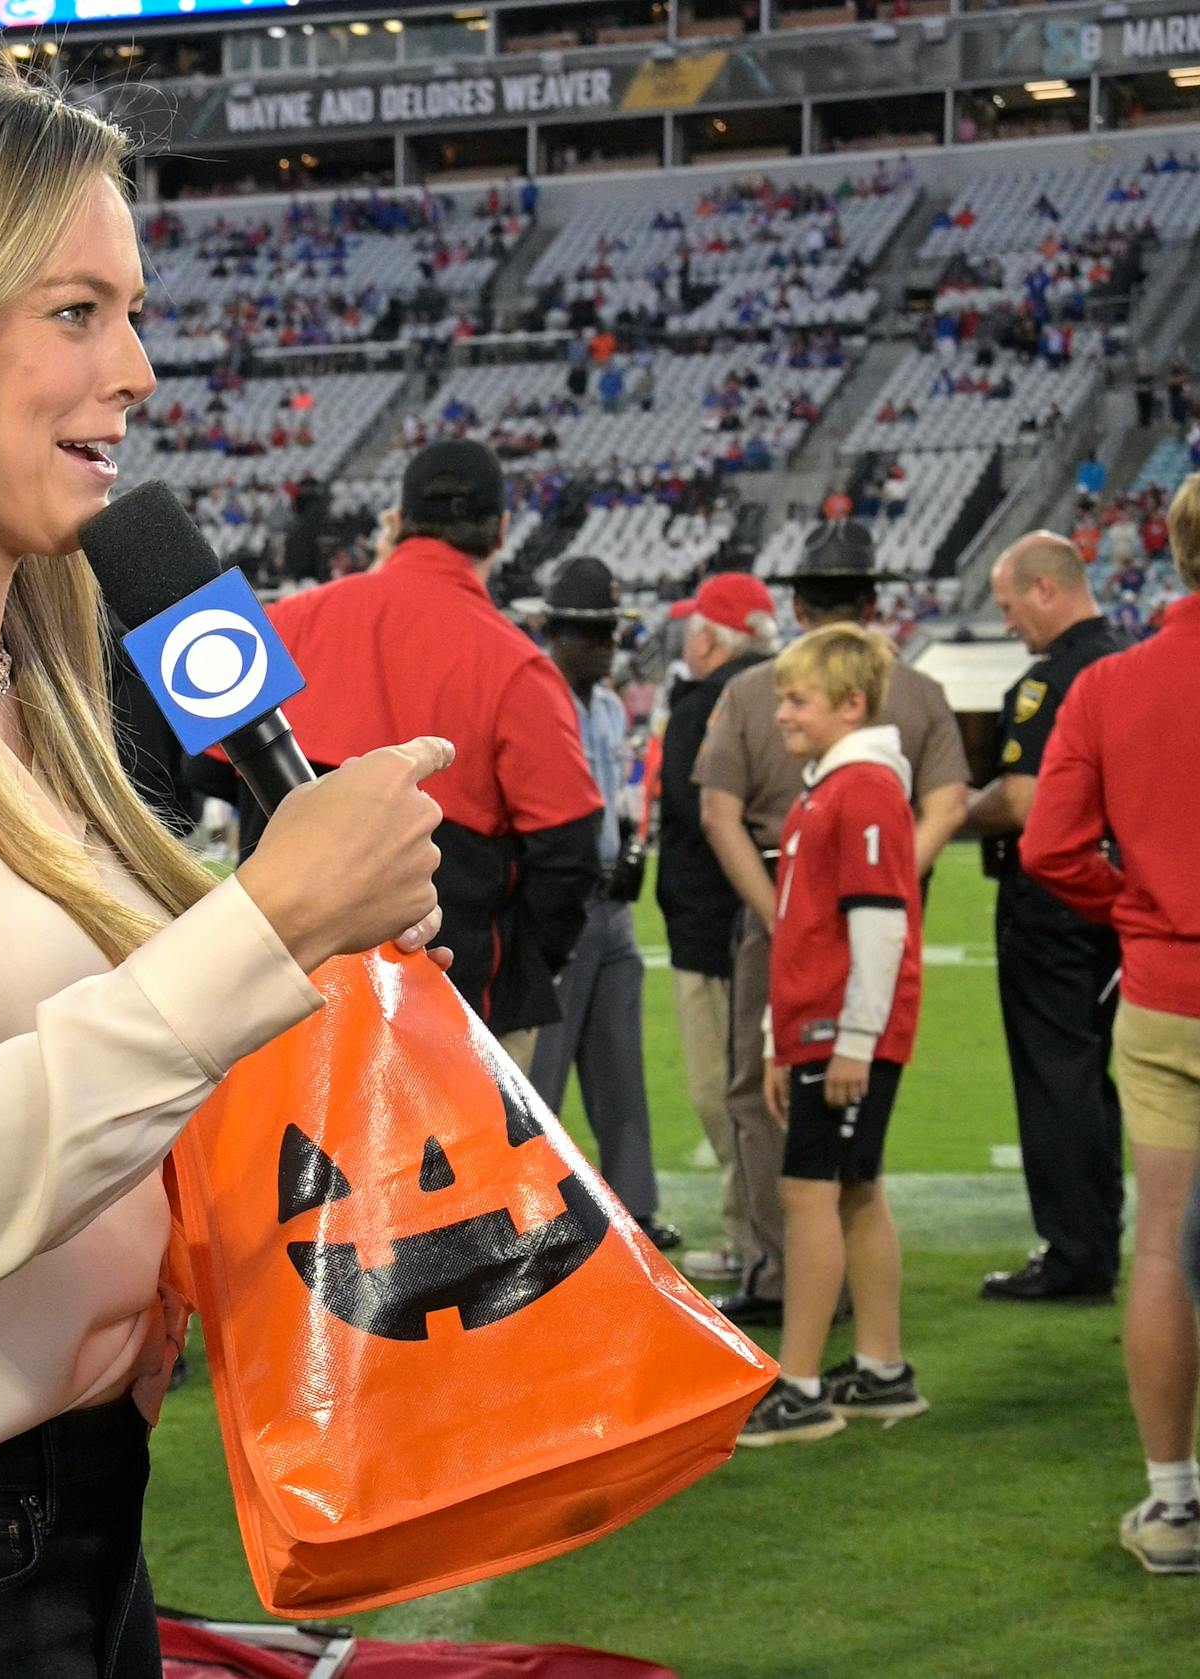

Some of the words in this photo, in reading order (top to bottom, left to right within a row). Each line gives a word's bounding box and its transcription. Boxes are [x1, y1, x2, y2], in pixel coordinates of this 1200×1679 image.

[227, 94, 312, 131] WAYNE
[320, 87, 374, 125] AND
[382, 79, 495, 121] DELORES
[502, 71, 611, 111] WEAVER
[864, 825, 879, 865] 1
